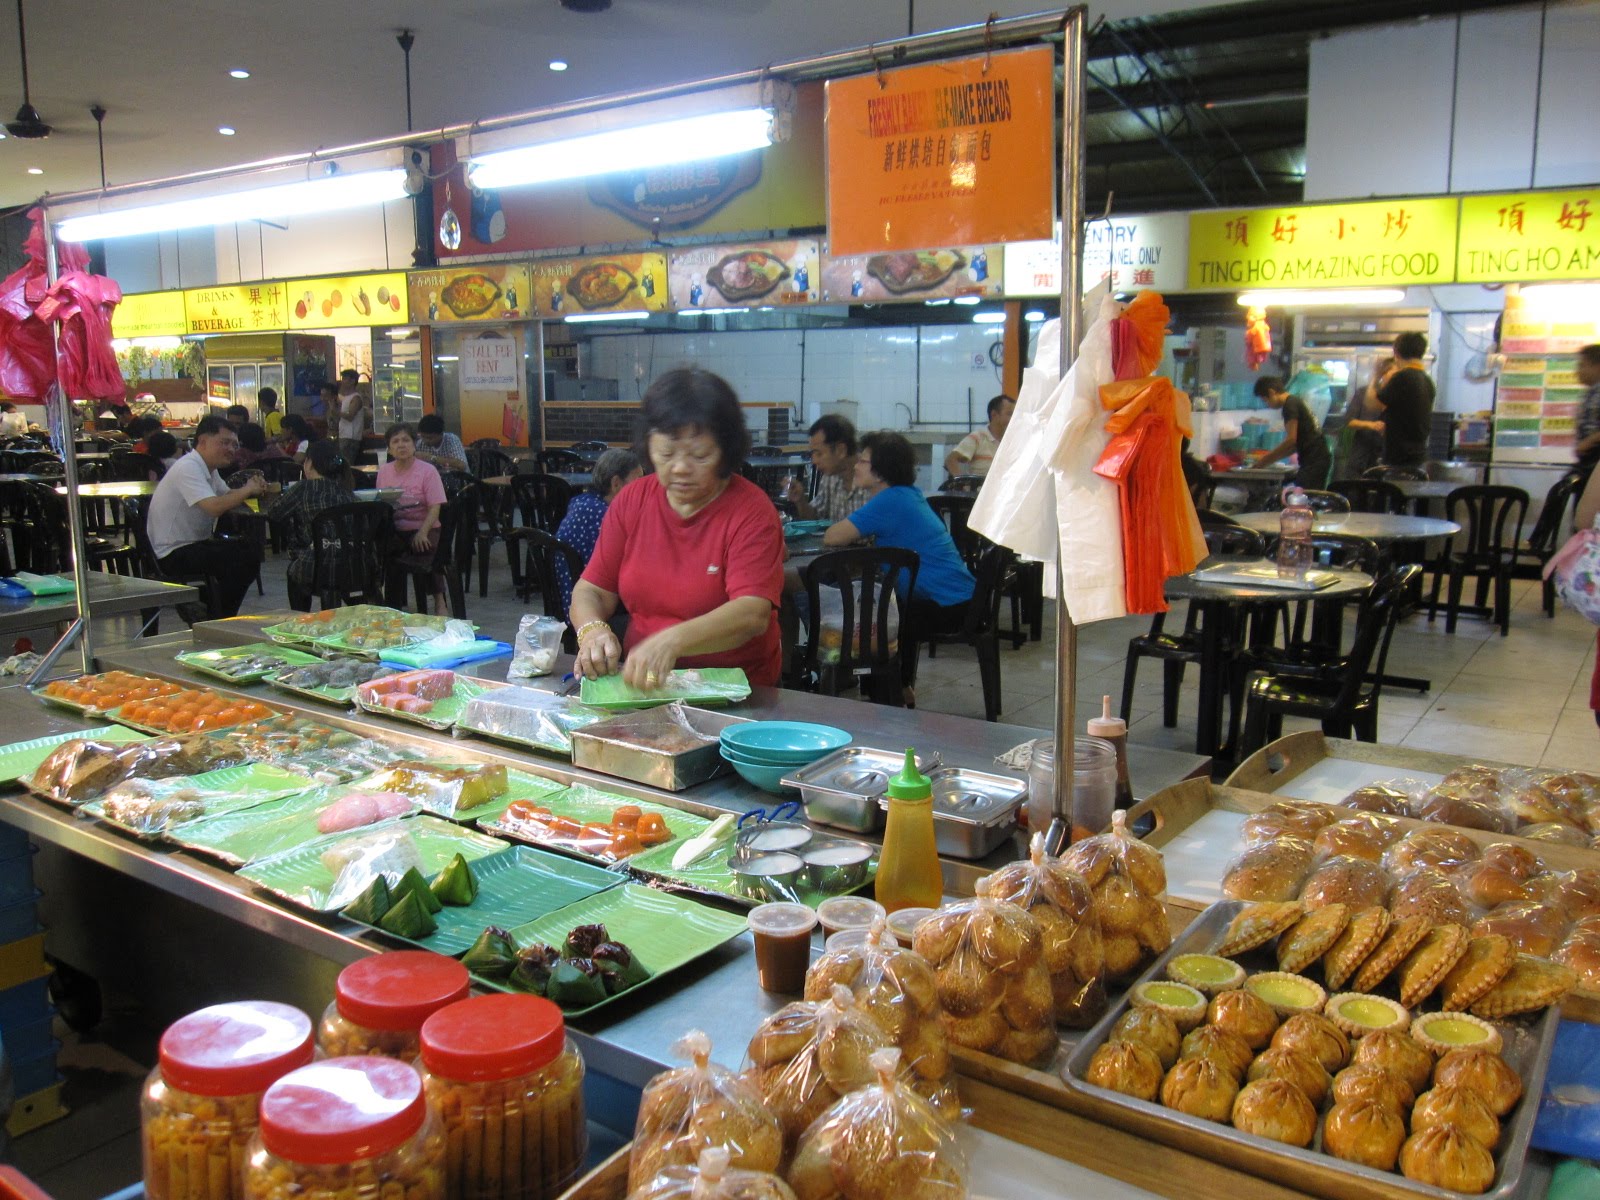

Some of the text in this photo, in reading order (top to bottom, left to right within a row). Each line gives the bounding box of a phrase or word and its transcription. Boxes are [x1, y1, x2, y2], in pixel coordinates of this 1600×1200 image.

[976, 78, 1011, 123] BREADS
[1224, 208, 1413, 247] 頂好小炒
[1139, 246, 1162, 265] ONLY
[1467, 247, 1520, 274] TING
[1526, 246, 1561, 272] HO
[1200, 252, 1440, 283] TING HO AMAZING FOOD
[197, 290, 235, 303] DRINKS
[249, 286, 281, 306] 果汁
[211, 306, 219, 317] &
[251, 308, 282, 328] 茶水
[192, 317, 246, 331] BEVERAGE
